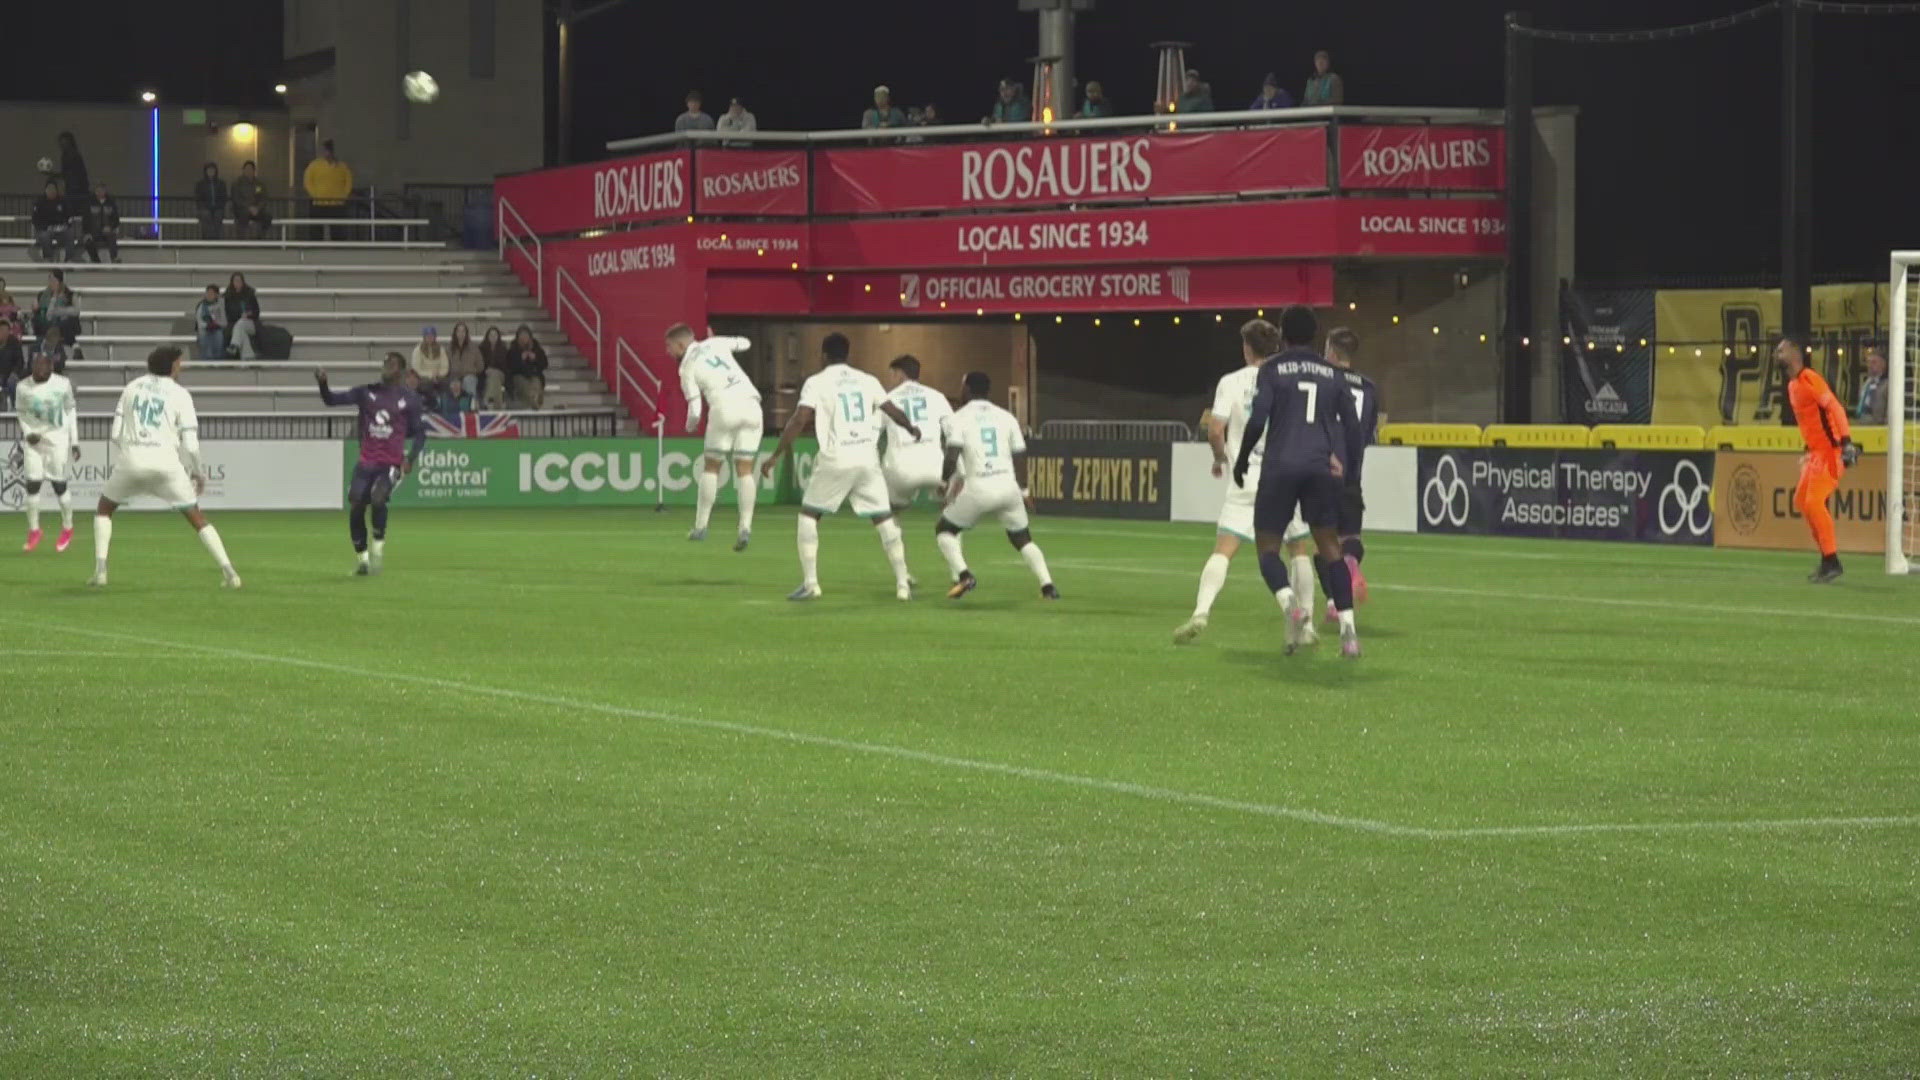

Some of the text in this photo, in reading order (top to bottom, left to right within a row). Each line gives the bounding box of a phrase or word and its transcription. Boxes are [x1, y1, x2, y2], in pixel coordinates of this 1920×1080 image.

[962, 139, 1152, 200] ROSAUERS
[1363, 138, 1490, 176] ROSAUERS
[595, 158, 683, 218] ROSAUERS
[703, 165, 800, 198] ROSAUERS
[958, 220, 1149, 251] LOCAL SINCE 1934
[1360, 216, 1415, 233] LOCAL
[1418, 217, 1467, 234] SINCE
[588, 243, 675, 276] LOCAL SINCE 1934
[696, 238, 799, 250] LOCAL SINCE 1934
[925, 273, 1161, 300] OFFICIAL GROCERY STORE
[837, 391, 866, 422] 13
[900, 396, 929, 422] 12
[1297, 381, 1317, 424] 7
[980, 427, 998, 457] 9
[418, 449, 470, 468] Idaho
[418, 467, 488, 486] Central
[1072, 458, 1132, 502] ZEPHYR
[1138, 459, 1158, 502] FC
[1472, 460, 1653, 498] Physical Therapy
